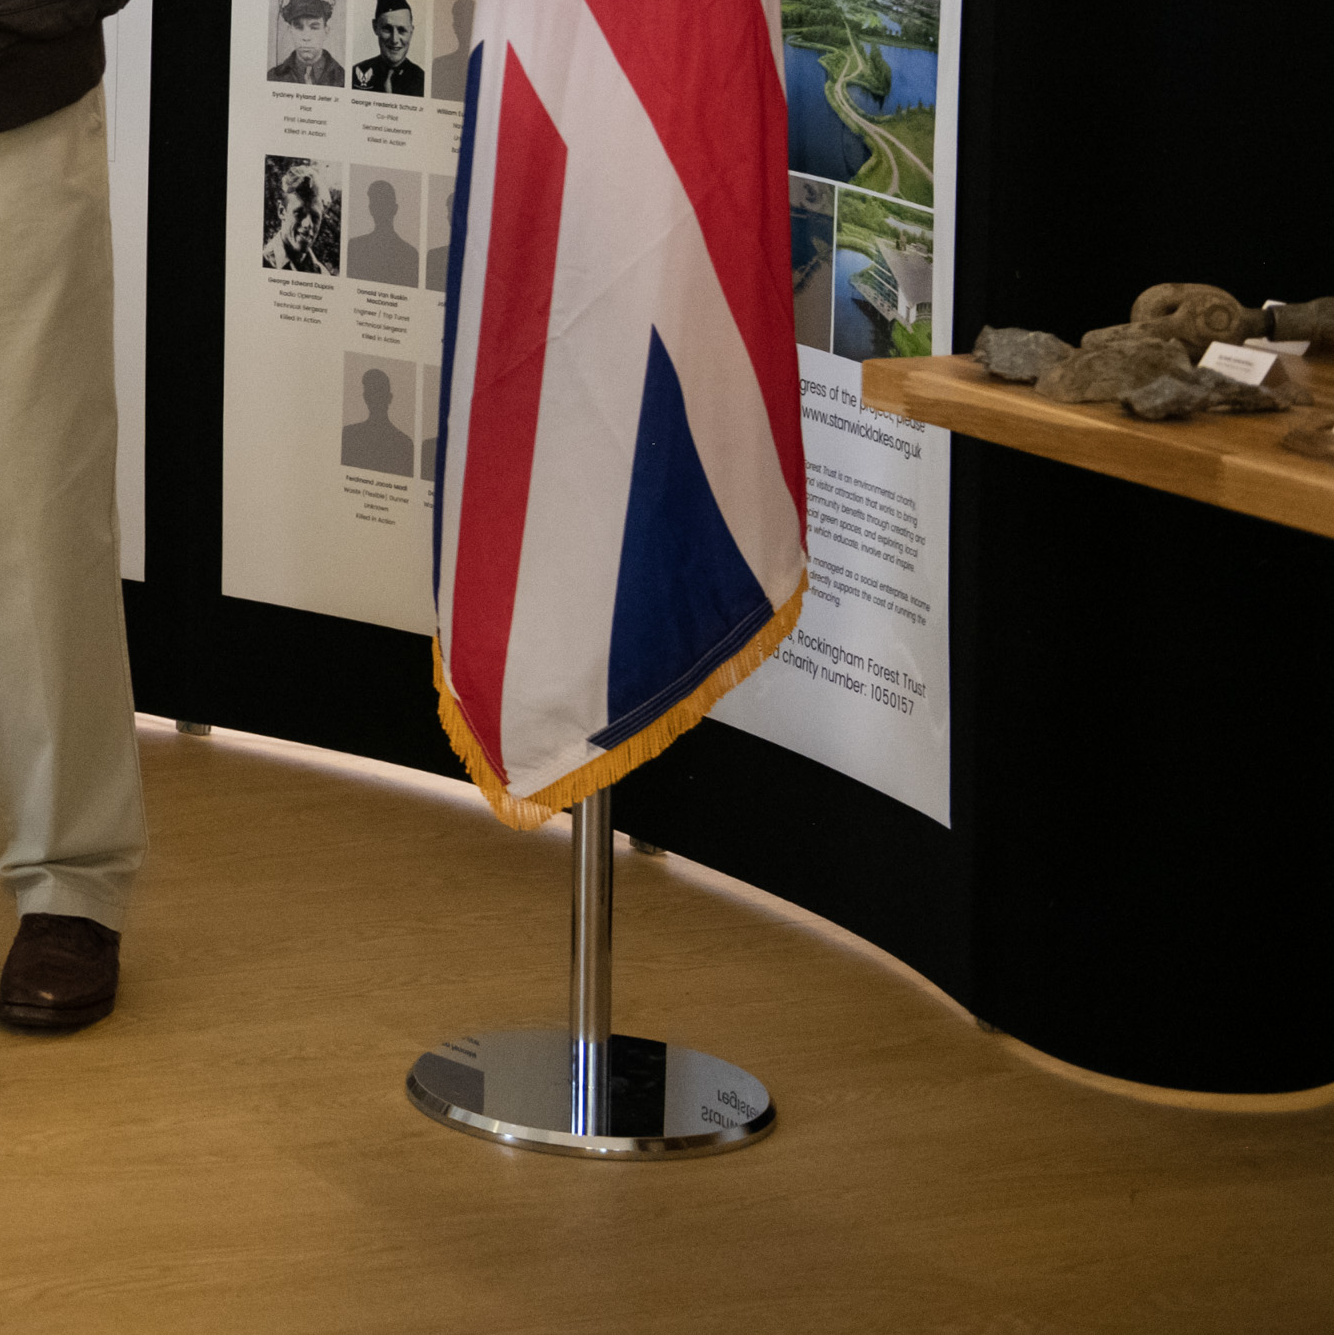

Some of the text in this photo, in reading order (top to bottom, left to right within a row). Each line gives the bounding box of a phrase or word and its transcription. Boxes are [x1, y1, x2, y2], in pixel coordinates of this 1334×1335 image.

[802, 405, 922, 460] www.stanwicklakes.org.uk
[782, 650, 914, 715] charity number: 1050157
[797, 629, 926, 698] Rockingham Forest Trust
